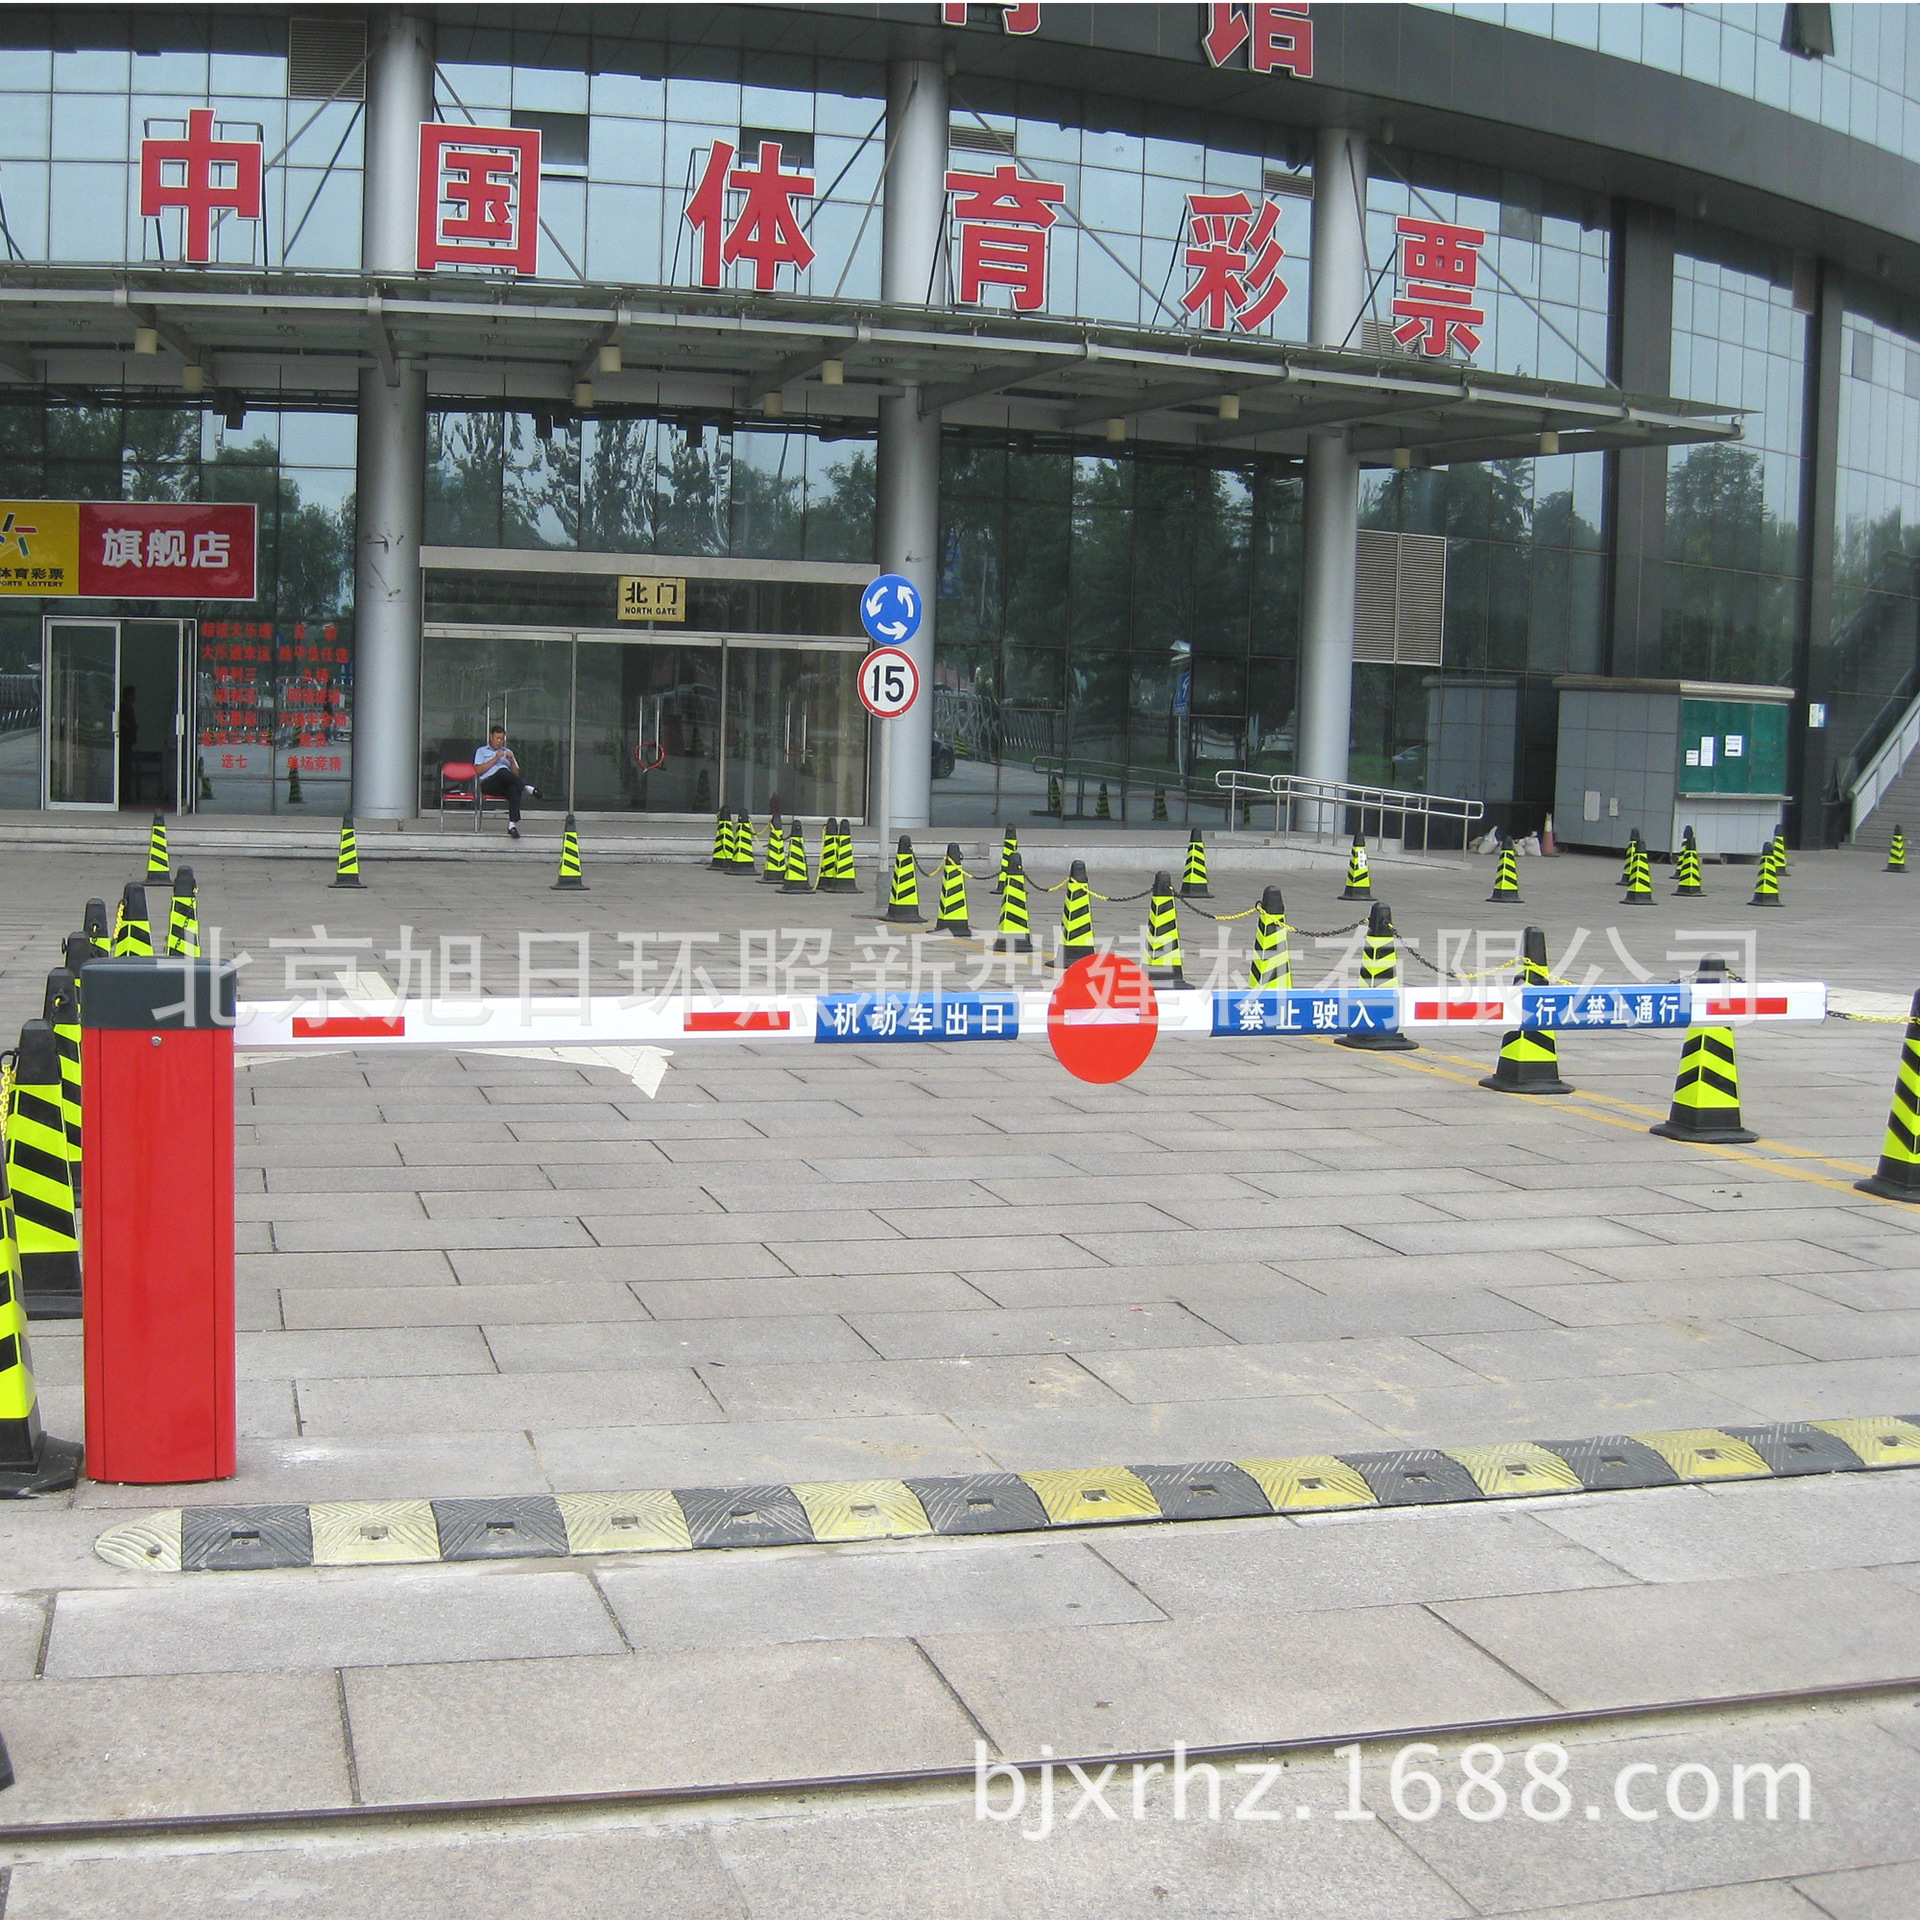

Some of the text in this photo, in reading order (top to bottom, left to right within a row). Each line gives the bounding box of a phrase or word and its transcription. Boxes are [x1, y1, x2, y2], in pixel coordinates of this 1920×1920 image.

[139, 107, 1485, 358] 中国体育彩票
[102, 527, 231, 568] 旗舰店
[625, 581, 678, 605] 北门
[625, 606, 677, 616] NORTH GATE
[873, 664, 905, 703] 15
[221, 753, 248, 769] 选七
[285, 755, 343, 772] 单场竞猜
[833, 1002, 1004, 1036] 机动车出口
[1239, 999, 1375, 1031] 禁止驶入
[1535, 995, 1679, 1027] 行人禁止通行
